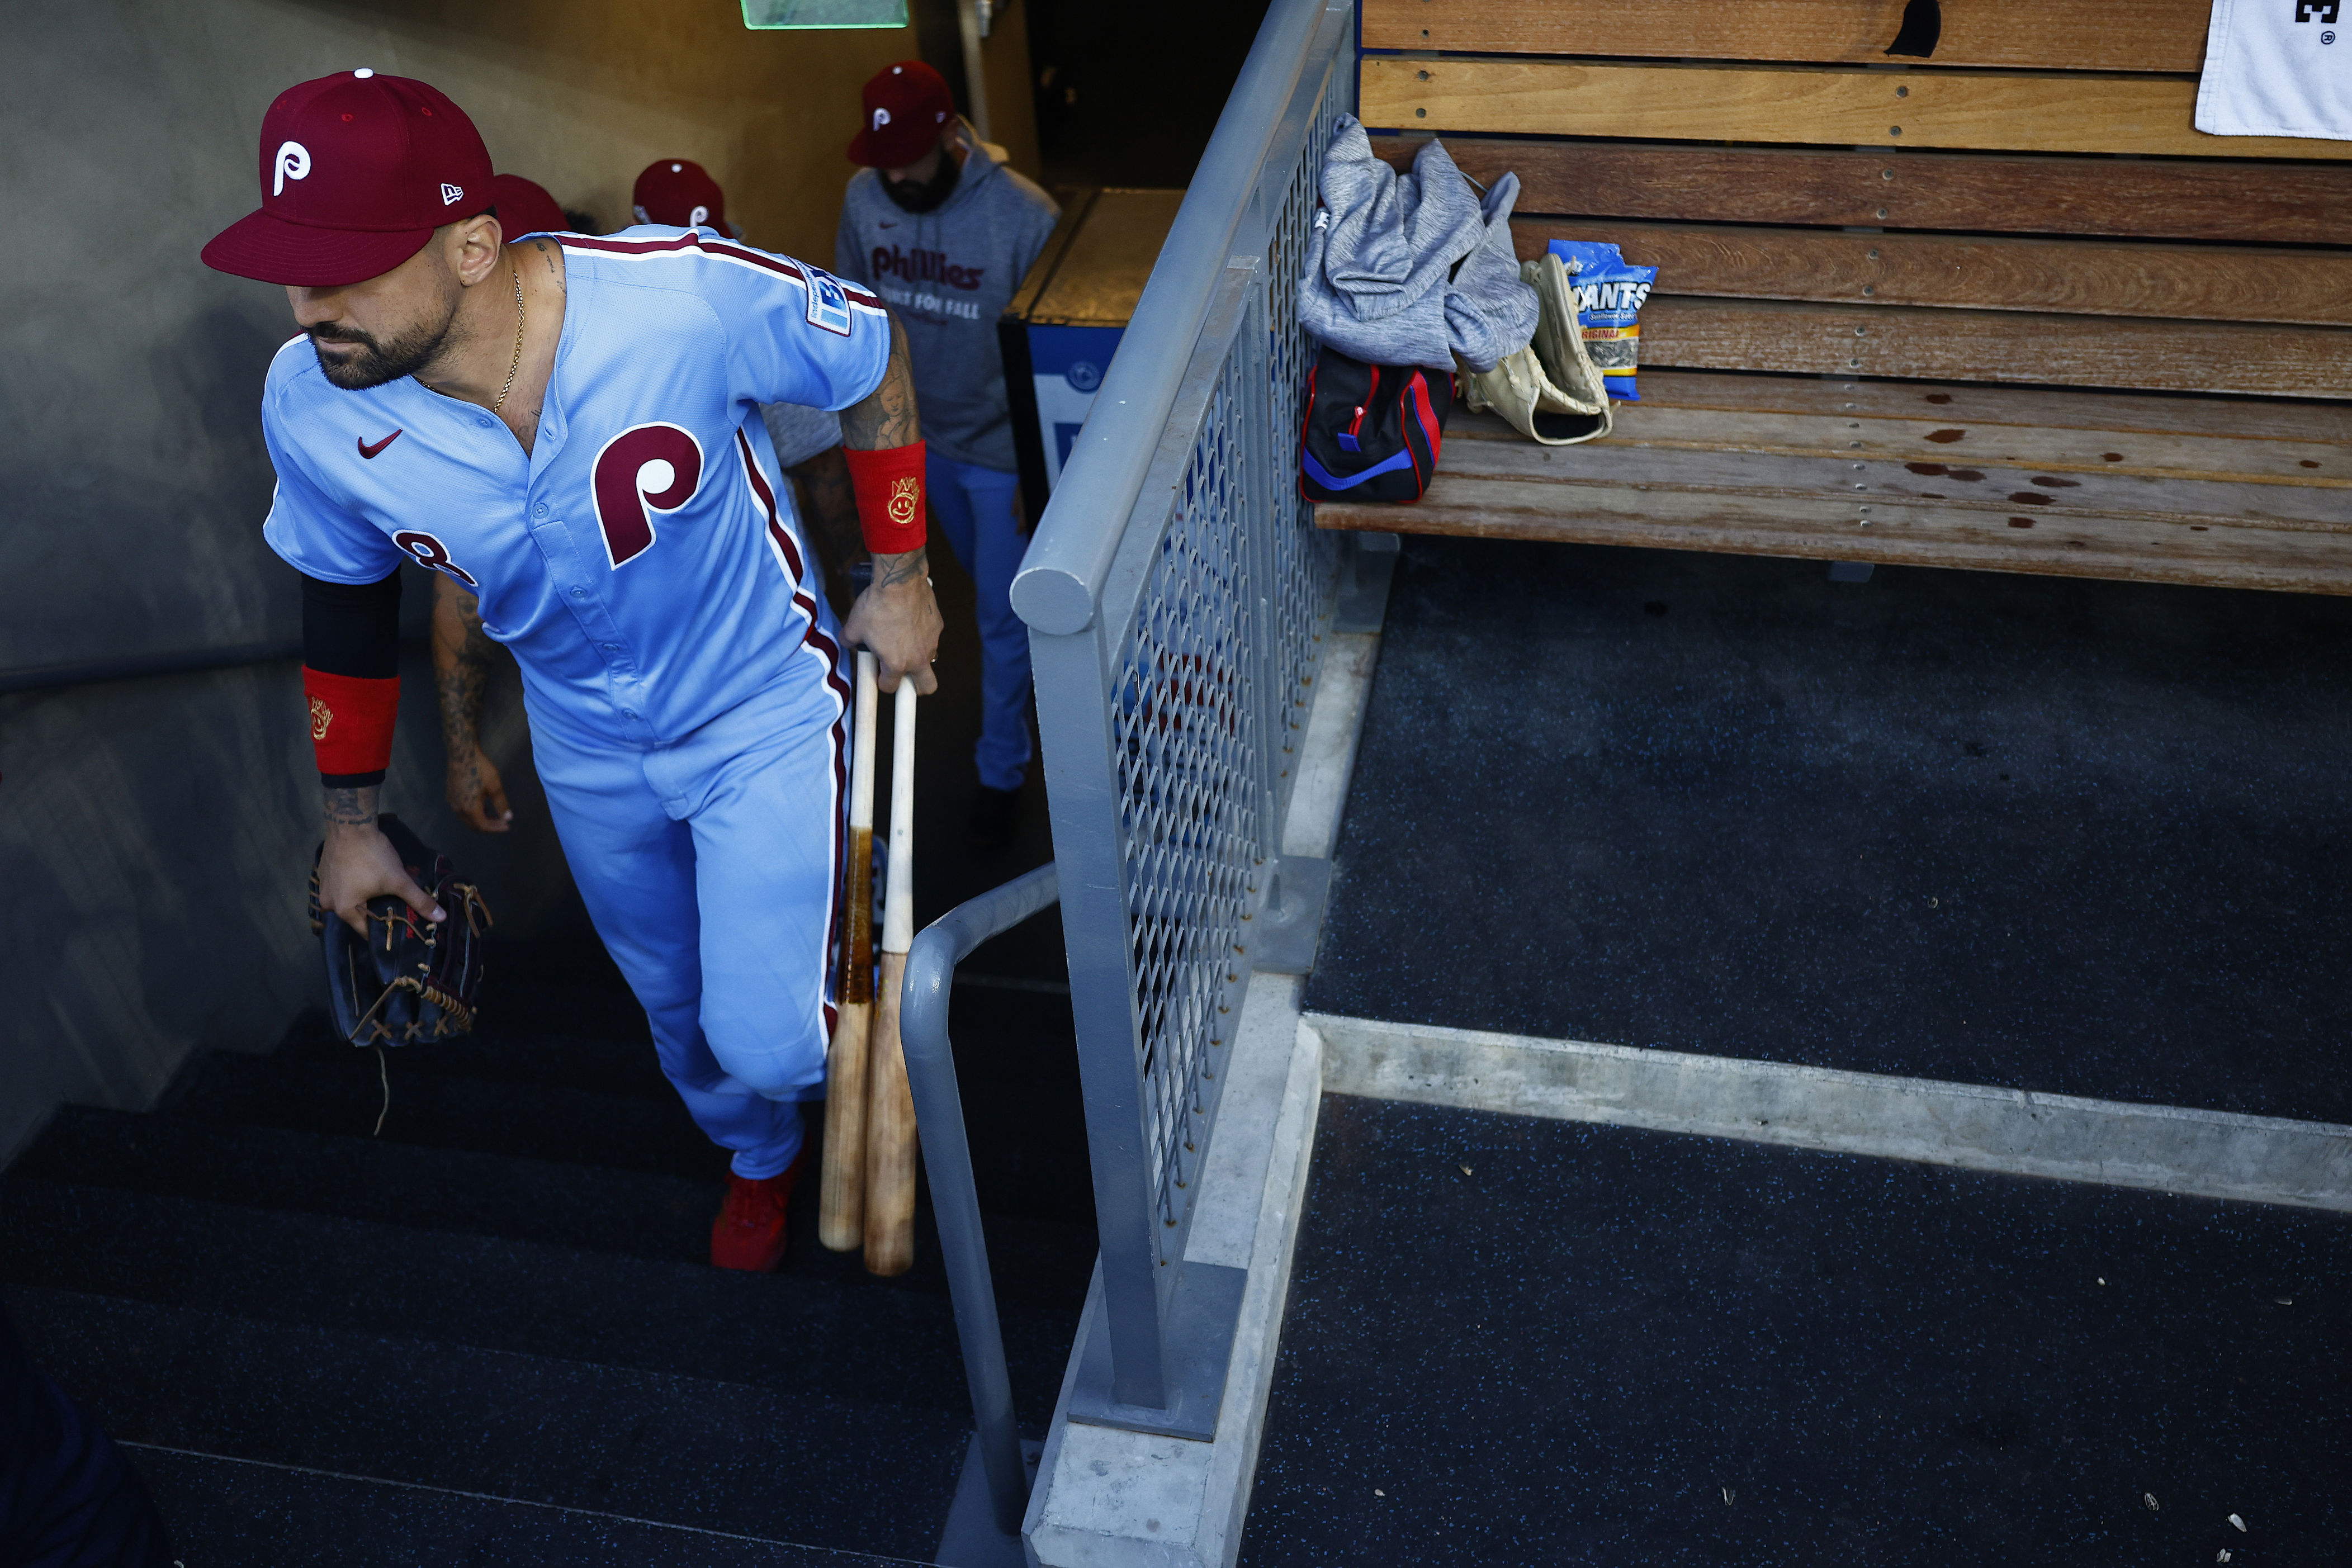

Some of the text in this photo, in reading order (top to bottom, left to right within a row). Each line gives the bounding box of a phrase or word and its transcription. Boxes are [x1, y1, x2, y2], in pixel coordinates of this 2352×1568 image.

[873, 107, 892, 131] P
[273, 141, 311, 196] P
[689, 205, 708, 228] P
[872, 244, 985, 291] Phillies
[914, 292, 944, 313] FOR
[945, 298, 980, 320] FALL
[590, 421, 705, 571] P
